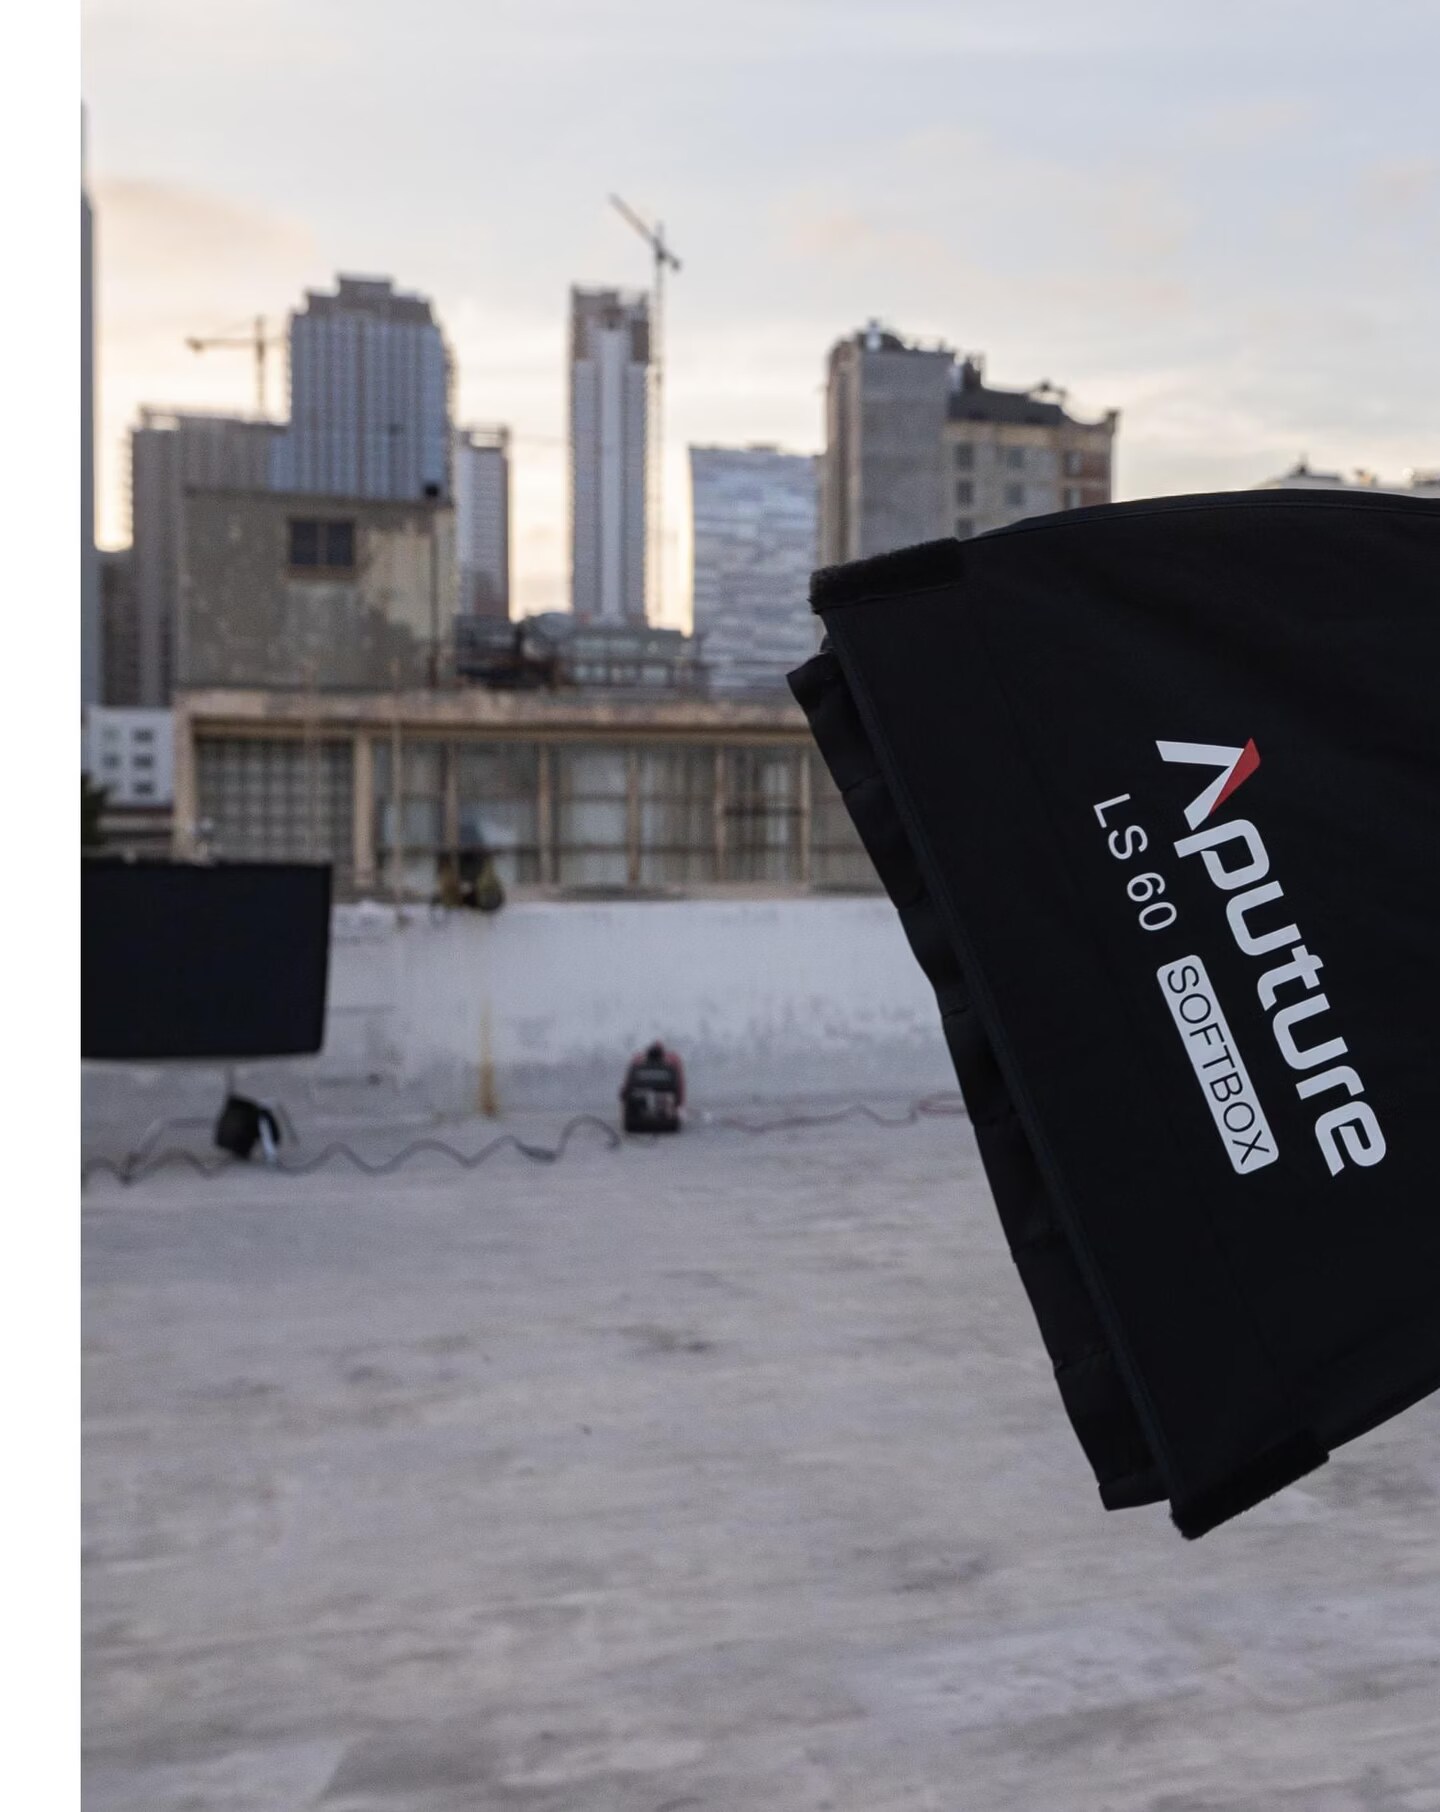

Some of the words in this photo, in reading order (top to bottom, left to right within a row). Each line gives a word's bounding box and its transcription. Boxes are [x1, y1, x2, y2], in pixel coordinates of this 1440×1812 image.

[1094, 793, 1149, 860] LS
[1126, 872, 1178, 932] 60
[1166, 964, 1271, 1165] SOFTBOX
[1156, 737, 1387, 1177] Aputure
